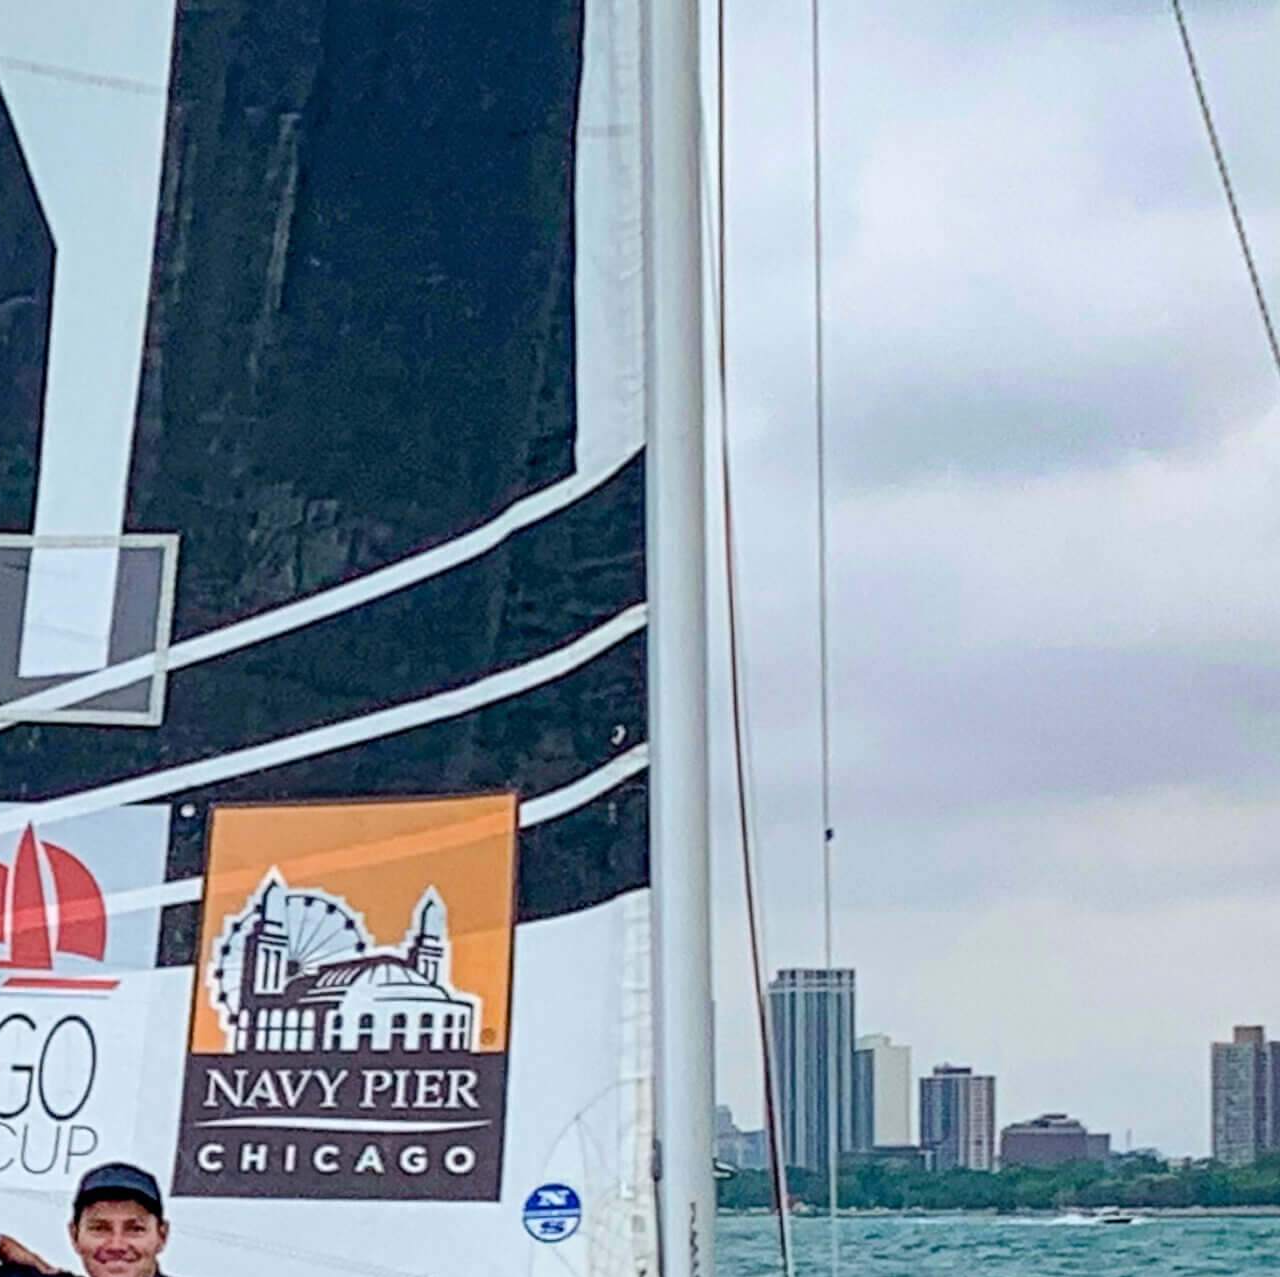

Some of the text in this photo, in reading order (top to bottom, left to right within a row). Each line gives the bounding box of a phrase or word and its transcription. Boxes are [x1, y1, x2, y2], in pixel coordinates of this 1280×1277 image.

[203, 1069, 480, 1109] NAVY PIER
[197, 1143, 477, 1174] CHICAGO
